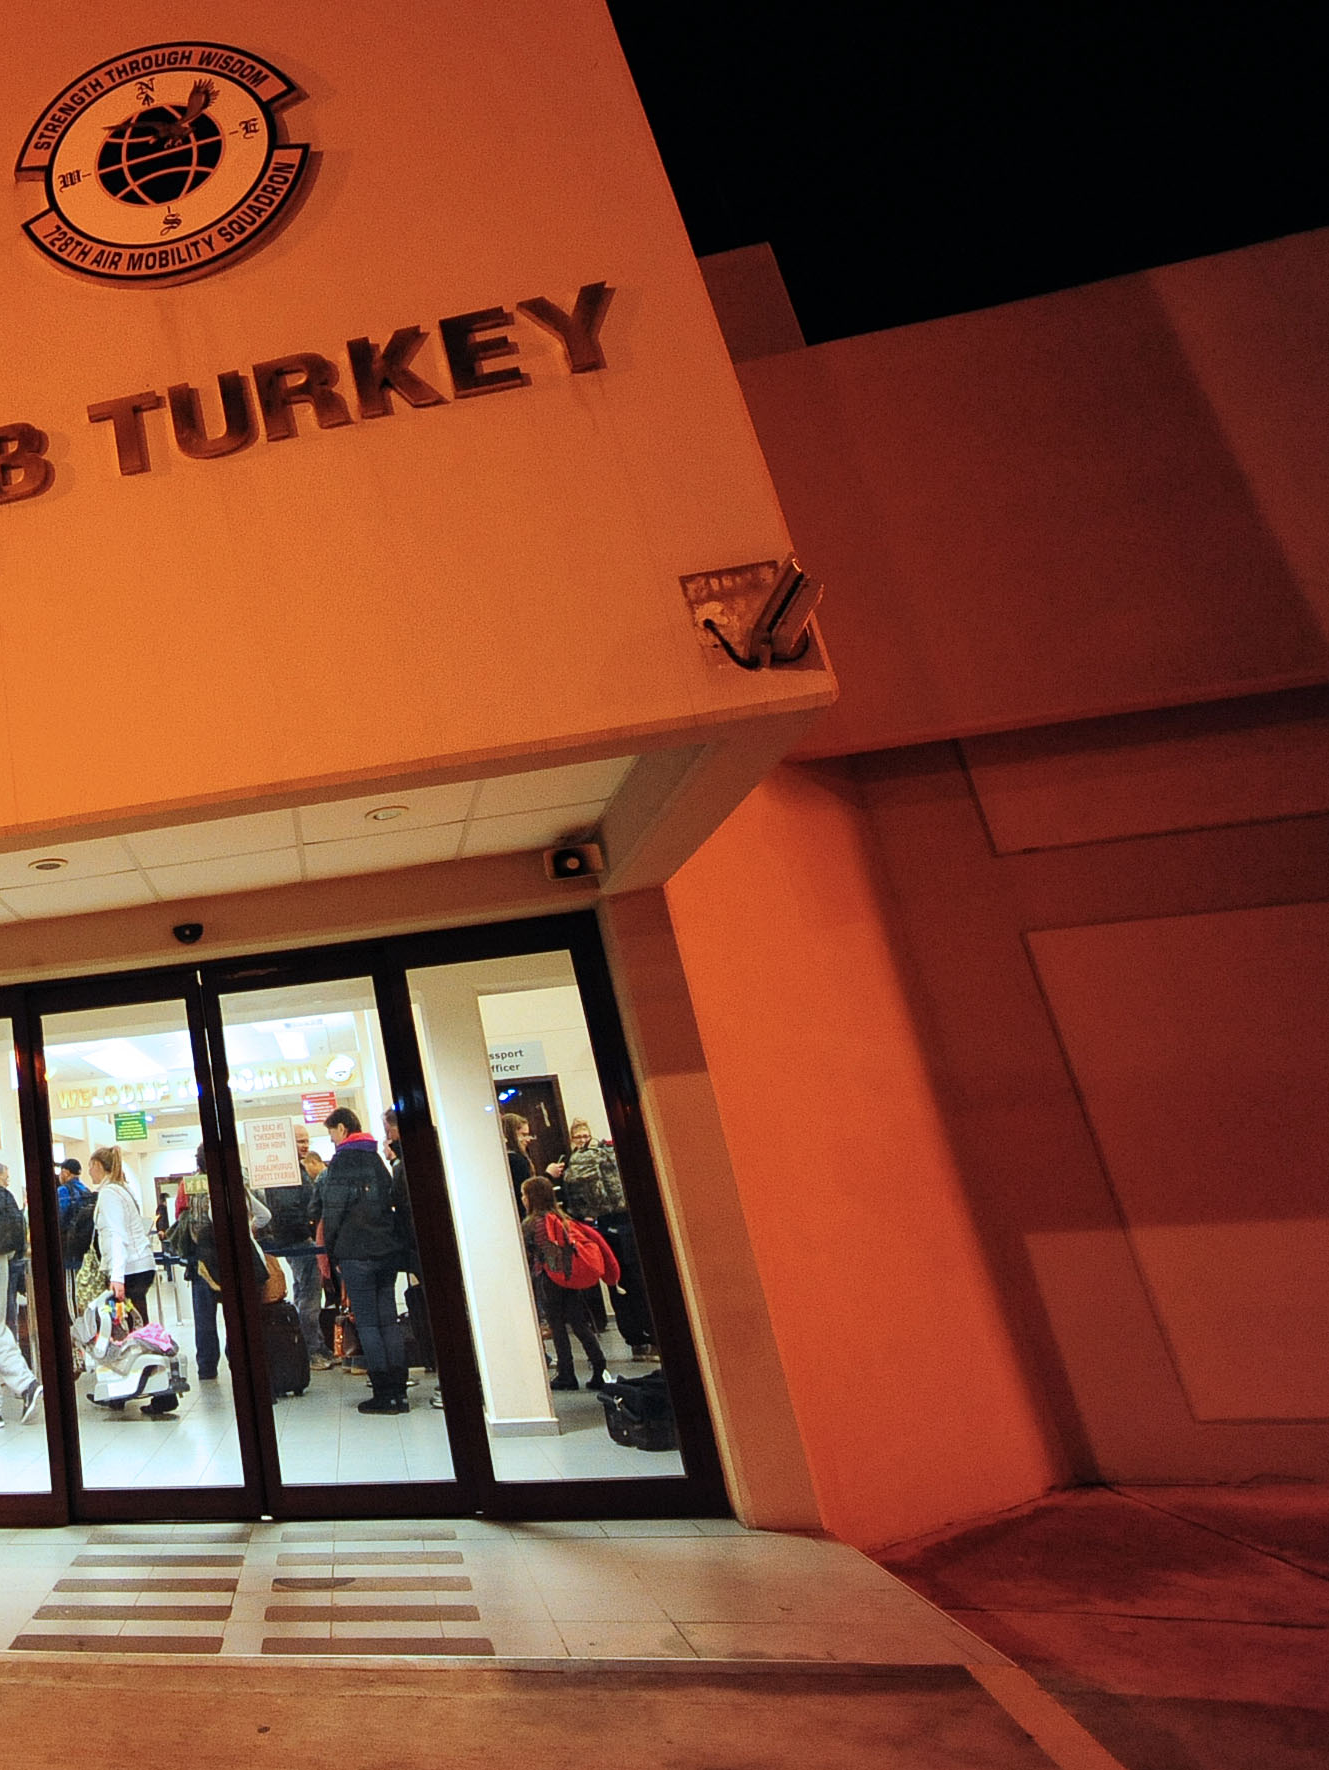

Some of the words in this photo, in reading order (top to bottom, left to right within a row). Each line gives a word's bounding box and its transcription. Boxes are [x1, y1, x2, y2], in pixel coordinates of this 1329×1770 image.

[34, 79, 105, 151] STRENGTH
[105, 50, 192, 84] THROUGH
[198, 51, 270, 89] WISDOM
[42, 224, 94, 263] 728TH
[91, 248, 123, 271] AIR
[126, 234, 216, 272] MOBILITY
[220, 160, 296, 243] SQUADRON
[87, 280, 616, 477] TURKEY
[488, 1049, 524, 1061] ssport
[491, 1063, 520, 1073] fficer
